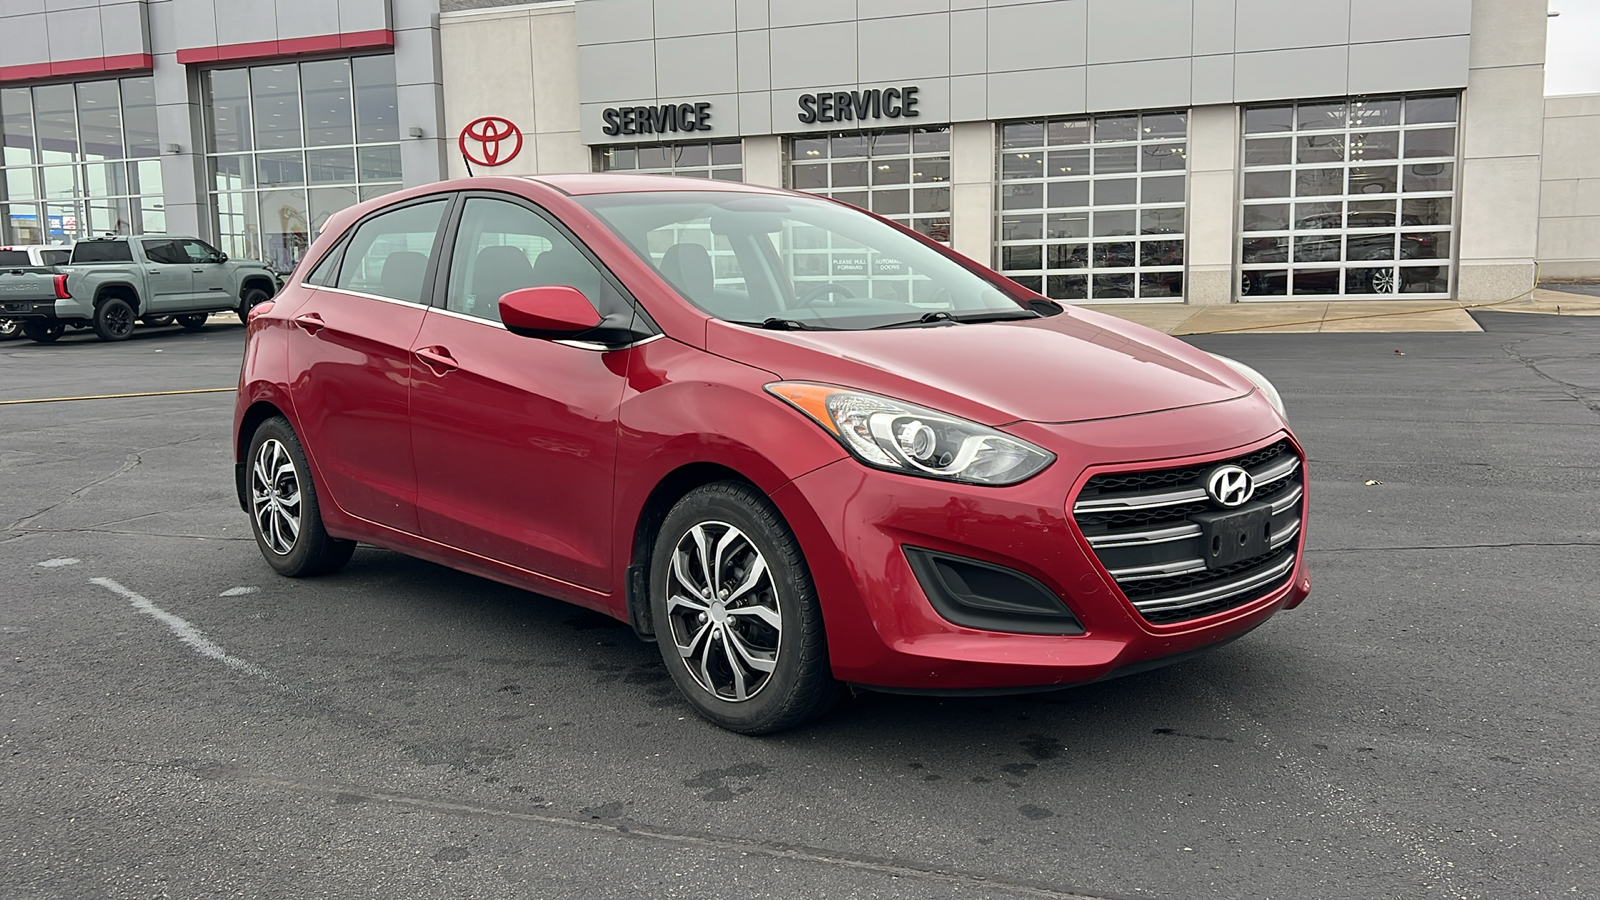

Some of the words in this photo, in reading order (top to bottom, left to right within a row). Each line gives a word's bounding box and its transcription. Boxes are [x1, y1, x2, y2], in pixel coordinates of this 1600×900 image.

[602, 102, 712, 136] SERVICE
[798, 86, 919, 124] SERVICE
[0, 283, 39, 291] TUNDRA
